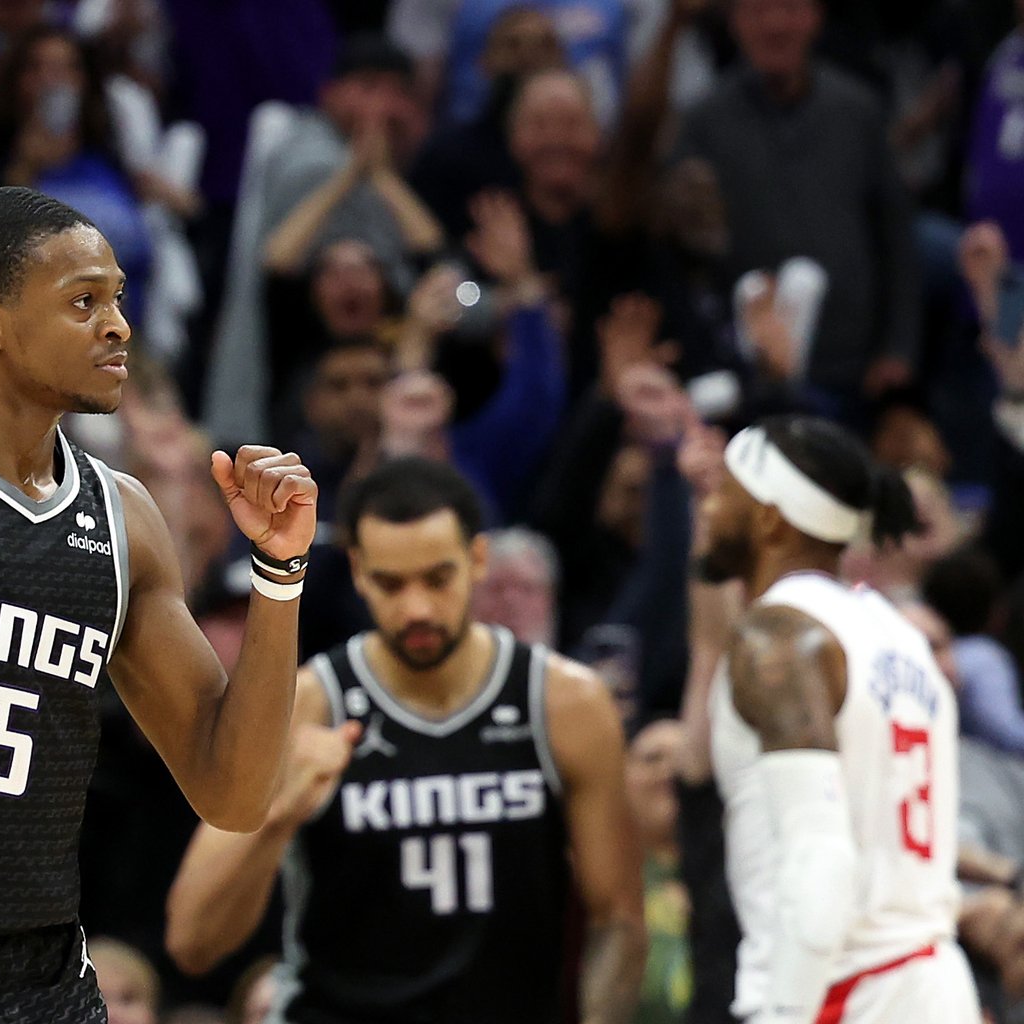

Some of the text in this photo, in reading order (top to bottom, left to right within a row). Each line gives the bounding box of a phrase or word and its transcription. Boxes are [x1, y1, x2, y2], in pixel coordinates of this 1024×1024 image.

[67, 532, 112, 556] dialpad
[340, 768, 545, 832] KINGS
[400, 831, 494, 915] 41
